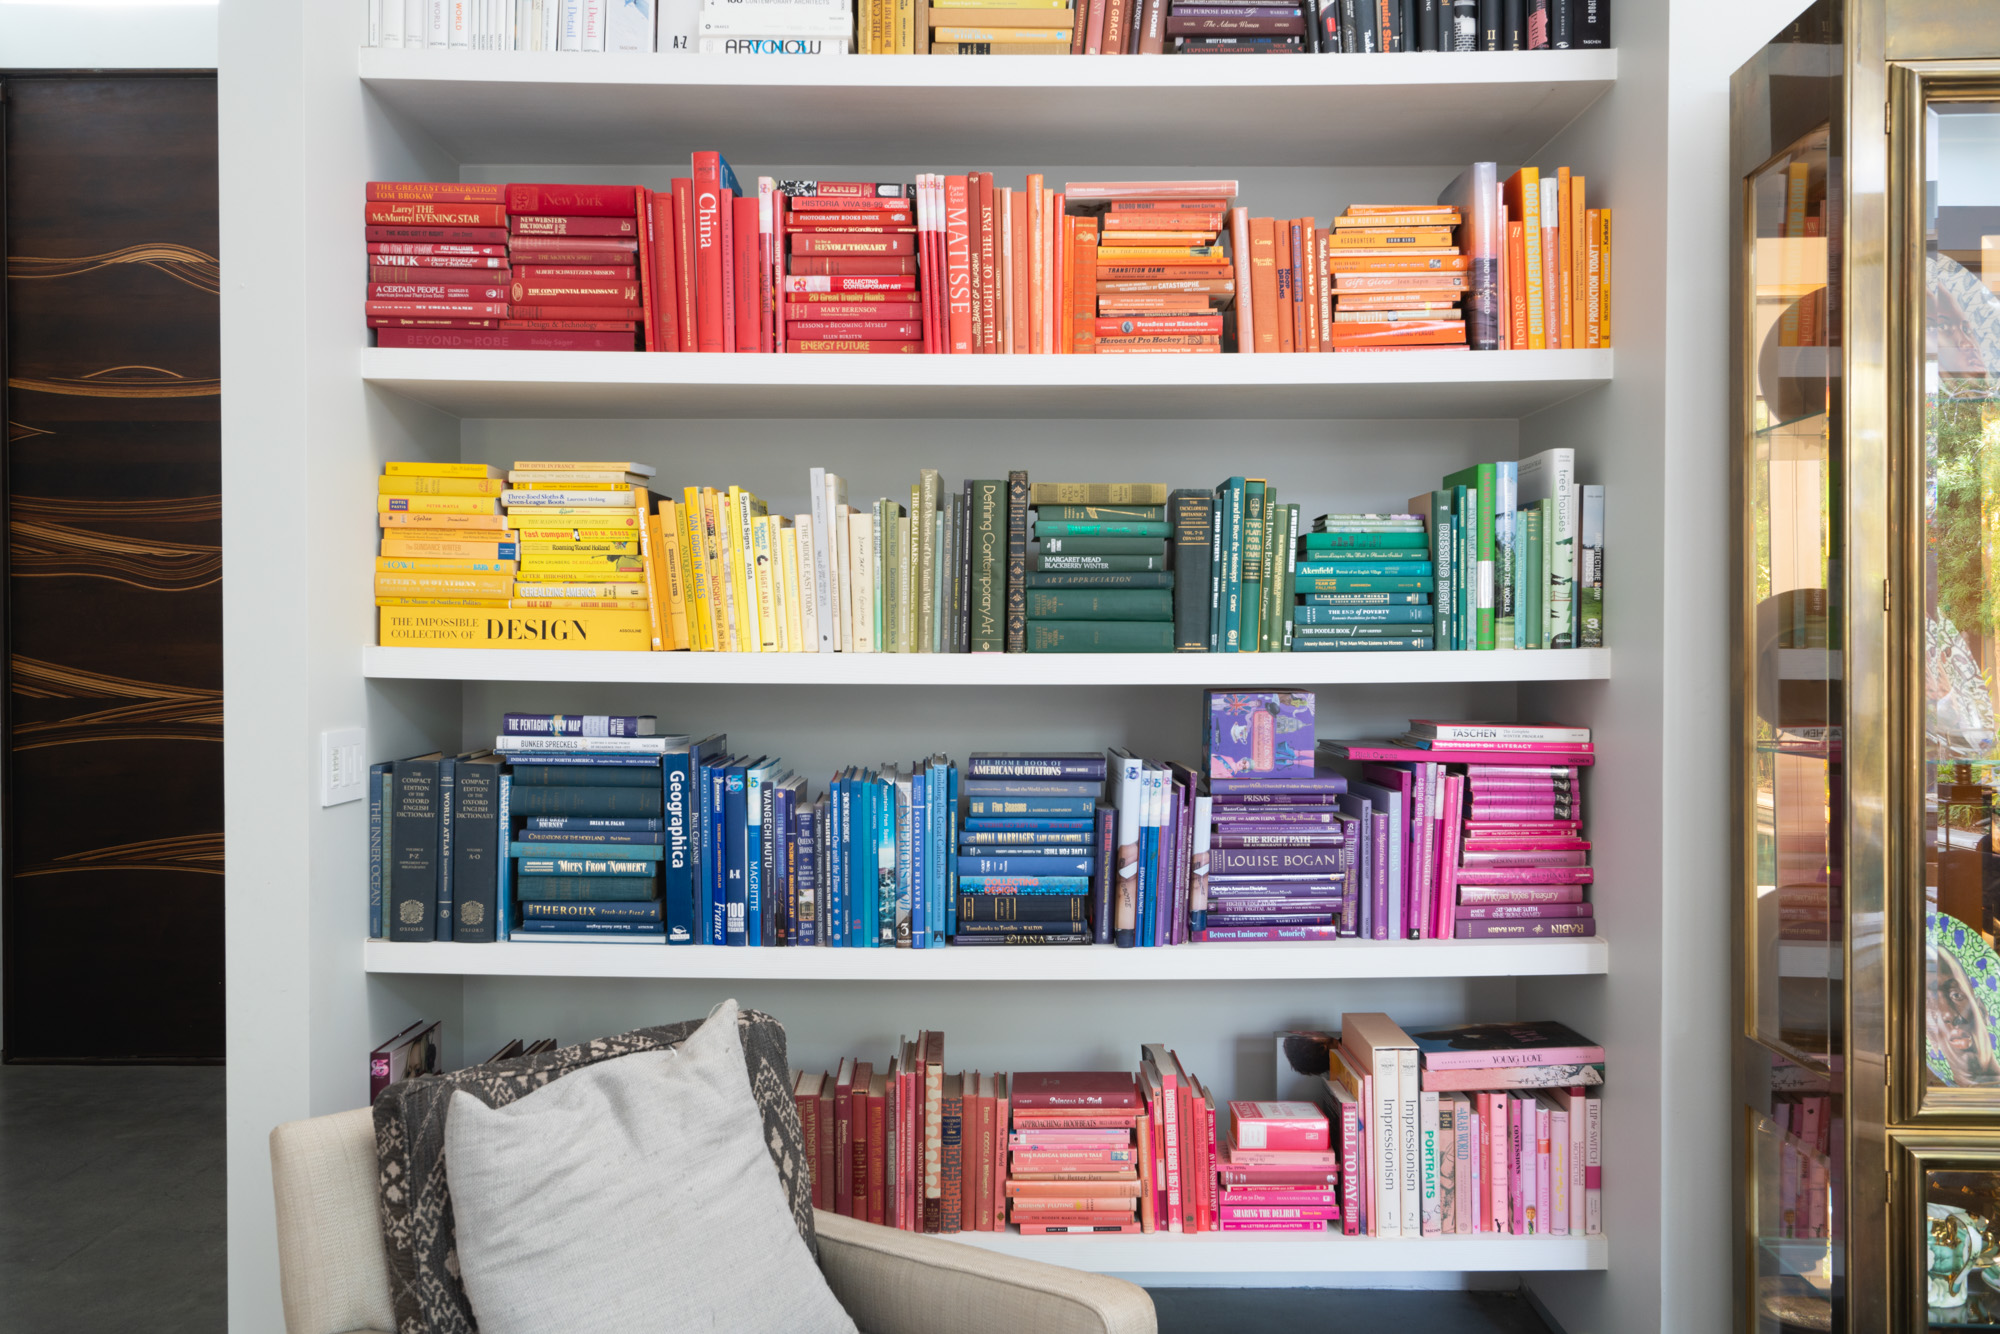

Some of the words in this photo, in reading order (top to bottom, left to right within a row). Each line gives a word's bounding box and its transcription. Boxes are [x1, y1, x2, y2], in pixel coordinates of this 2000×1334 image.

[567, 6, 577, 38] Detail
[588, 7, 598, 38] Detail
[1109, 6, 1120, 41] GRACE
[1203, 20, 1216, 28] The
[1220, 20, 1237, 28] Adams
[1530, 13, 1539, 47] PARIS
[544, 193, 570, 206] New
[575, 194, 602, 206] York
[822, 185, 857, 193] PARIS
[1525, 183, 1537, 214] 2000
[373, 214, 412, 223] McMurtry
[392, 205, 412, 214] Larry
[416, 205, 434, 213] THE
[416, 214, 456, 223] EVENING
[458, 215, 480, 223] STAR
[698, 193, 717, 249] China
[982, 205, 991, 229] PAST
[983, 235, 992, 259] THE
[1527, 217, 1540, 285] JERUSALEM
[947, 208, 969, 314] MATISSE
[983, 264, 992, 279] OF
[983, 285, 992, 320] LIGHT
[1528, 285, 1542, 335] CHIHULY
[1589, 276, 1599, 322] PRODUCTION
[1515, 295, 1526, 345] homage
[801, 341, 834, 350] ENERGY
[836, 341, 870, 350] FUTURE
[984, 323, 993, 347] THE
[1152, 336, 1181, 344] Hockey
[1589, 325, 1599, 344] PLAY
[1559, 470, 1568, 491] tree
[742, 496, 750, 524] Symbol
[980, 485, 996, 531] Defining
[1559, 495, 1570, 532] houses
[541, 531, 573, 539] company
[689, 514, 697, 532] VAN
[691, 534, 700, 553] GOGH
[1439, 524, 1449, 577] DRESSING
[694, 555, 701, 570] IN
[979, 532, 995, 615] Contemporary
[520, 588, 563, 597] CEREALIZING
[566, 588, 596, 597] AMERICA
[696, 573, 705, 599] ARLES
[1439, 581, 1449, 614] RIGHT
[391, 617, 412, 626] THE
[416, 617, 479, 627] IMPOSSIBLE
[487, 619, 589, 640] DESIGN
[982, 616, 994, 634] Art
[391, 630, 459, 639] COLLECTION
[461, 630, 475, 639] OF
[509, 718, 520, 730] THE
[521, 719, 553, 731] PENTAGON'S
[555, 719, 567, 731] NEW
[568, 720, 580, 731] MAP
[1452, 729, 1496, 738] TASCHEN
[521, 740, 543, 748] BUNKER
[974, 766, 1014, 775] AMERICAN
[1014, 767, 1061, 776] QUOTATIONS
[372, 800, 380, 823] THE
[667, 771, 687, 868] Geographica
[764, 789, 772, 839] WANGECHI
[372, 826, 380, 862] INNER
[764, 842, 772, 868] MUTU
[1424, 823, 1433, 885] MICHELANGELO
[558, 860, 583, 873] MILES
[586, 861, 605, 872] FROM
[608, 861, 648, 873] NOWHERE
[915, 857, 920, 867] IN
[1228, 856, 1278, 867] LOUISE
[1284, 855, 1335, 866] BOGAN
[371, 864, 380, 906] OCEAN
[750, 862, 758, 911] MAGRITTE
[534, 905, 596, 916] THEROUX
[714, 902, 725, 940] France
[1493, 1056, 1520, 1064] YOUNG
[1343, 1112, 1355, 1149] HELL
[1380, 1099, 1397, 1190] Impressionism
[1402, 1100, 1418, 1191] Impressionism
[1344, 1152, 1356, 1171] TO
[1425, 1131, 1435, 1199] PORTRAITS
[1345, 1174, 1357, 1201] PAY
[1259, 1209, 1270, 1217] THE
[1272, 1209, 1300, 1217] DELIRIUM
